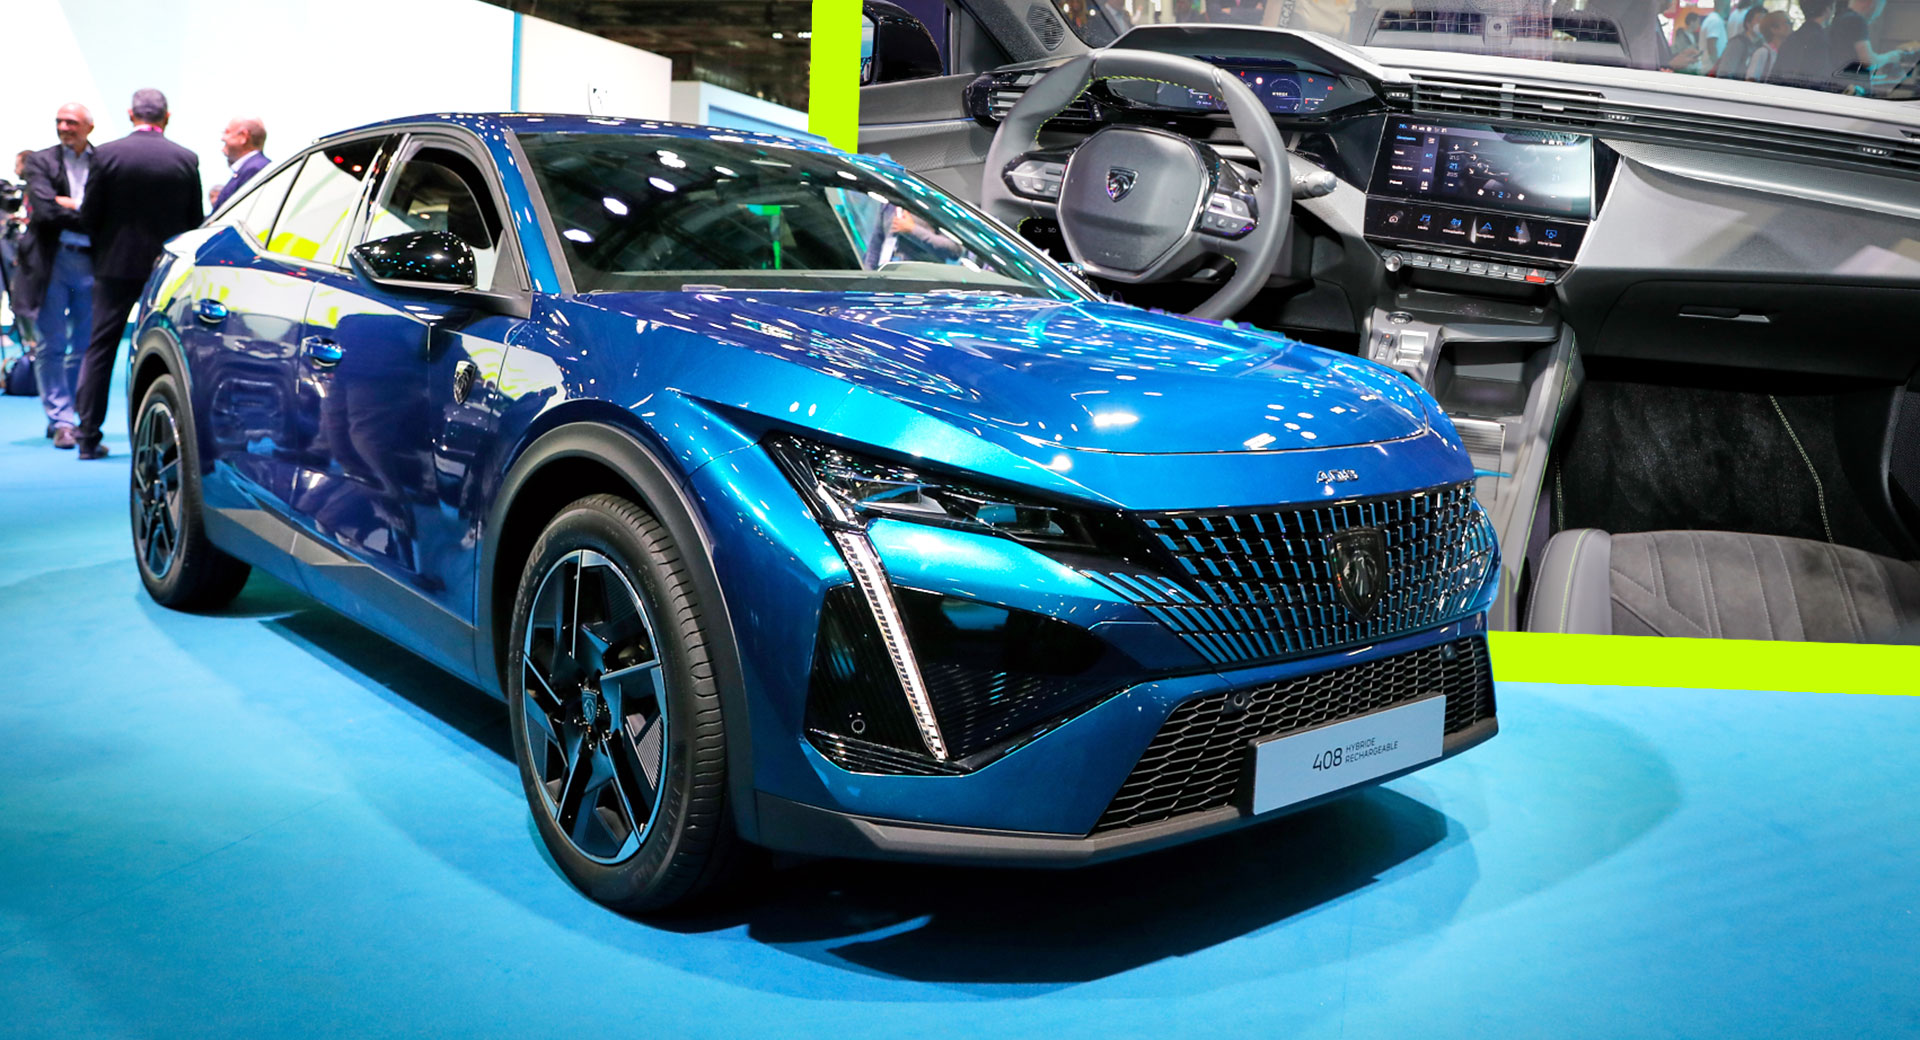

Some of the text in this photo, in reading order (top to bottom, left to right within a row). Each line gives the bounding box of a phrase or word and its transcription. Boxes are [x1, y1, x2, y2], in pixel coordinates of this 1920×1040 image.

[1345, 737, 1376, 753] HYBRIDE
[1345, 741, 1399, 763] RECHARGEABLE
[1312, 747, 1343, 772] 408
